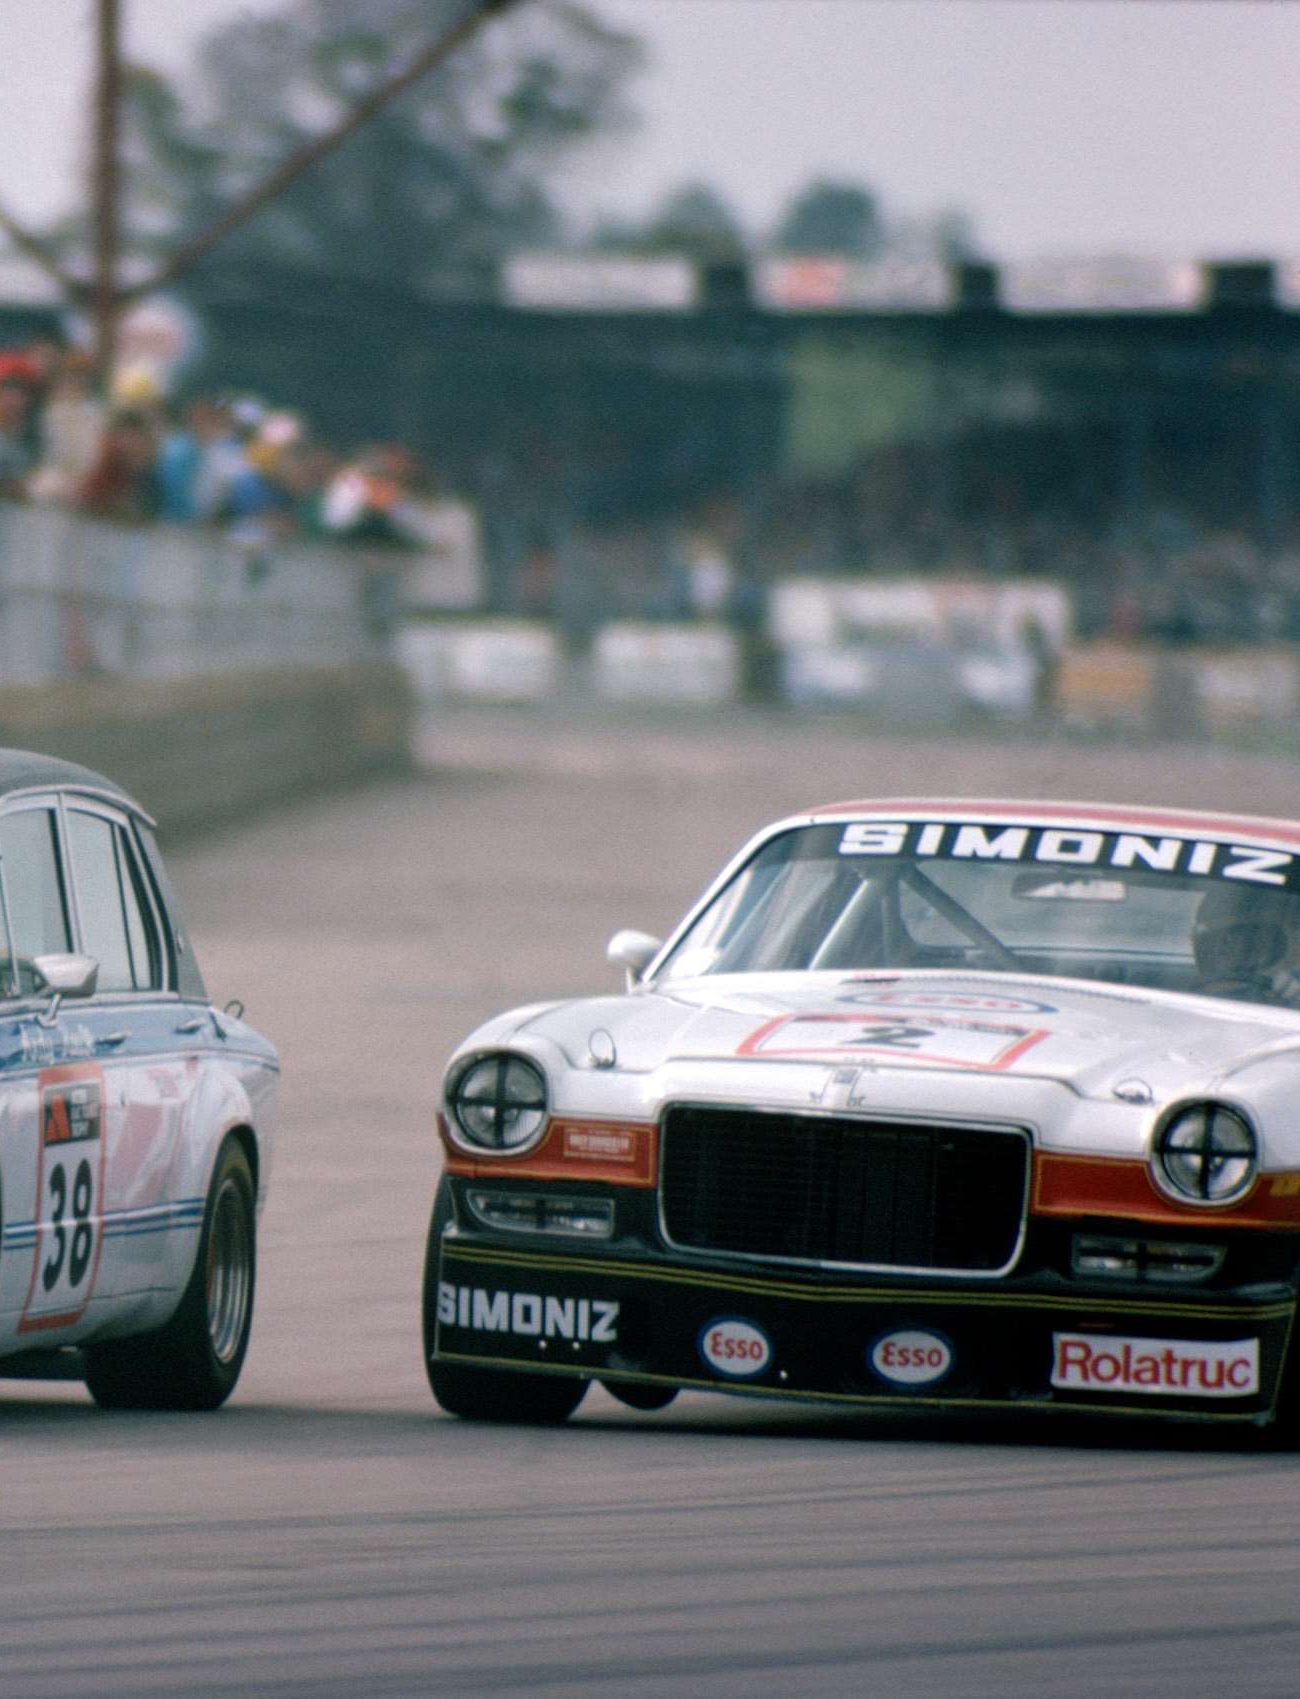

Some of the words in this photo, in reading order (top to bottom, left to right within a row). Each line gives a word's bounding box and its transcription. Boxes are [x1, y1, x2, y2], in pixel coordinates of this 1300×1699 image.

[837, 823, 1293, 886] SIMONIZ
[838, 1025, 936, 1049] 2
[42, 1158, 93, 1293] 38
[437, 1281, 620, 1342] SIMONIZ
[709, 1330, 764, 1362] Esso
[881, 1341, 944, 1369] Esso
[1057, 1339, 1251, 1389] Rolatruc
